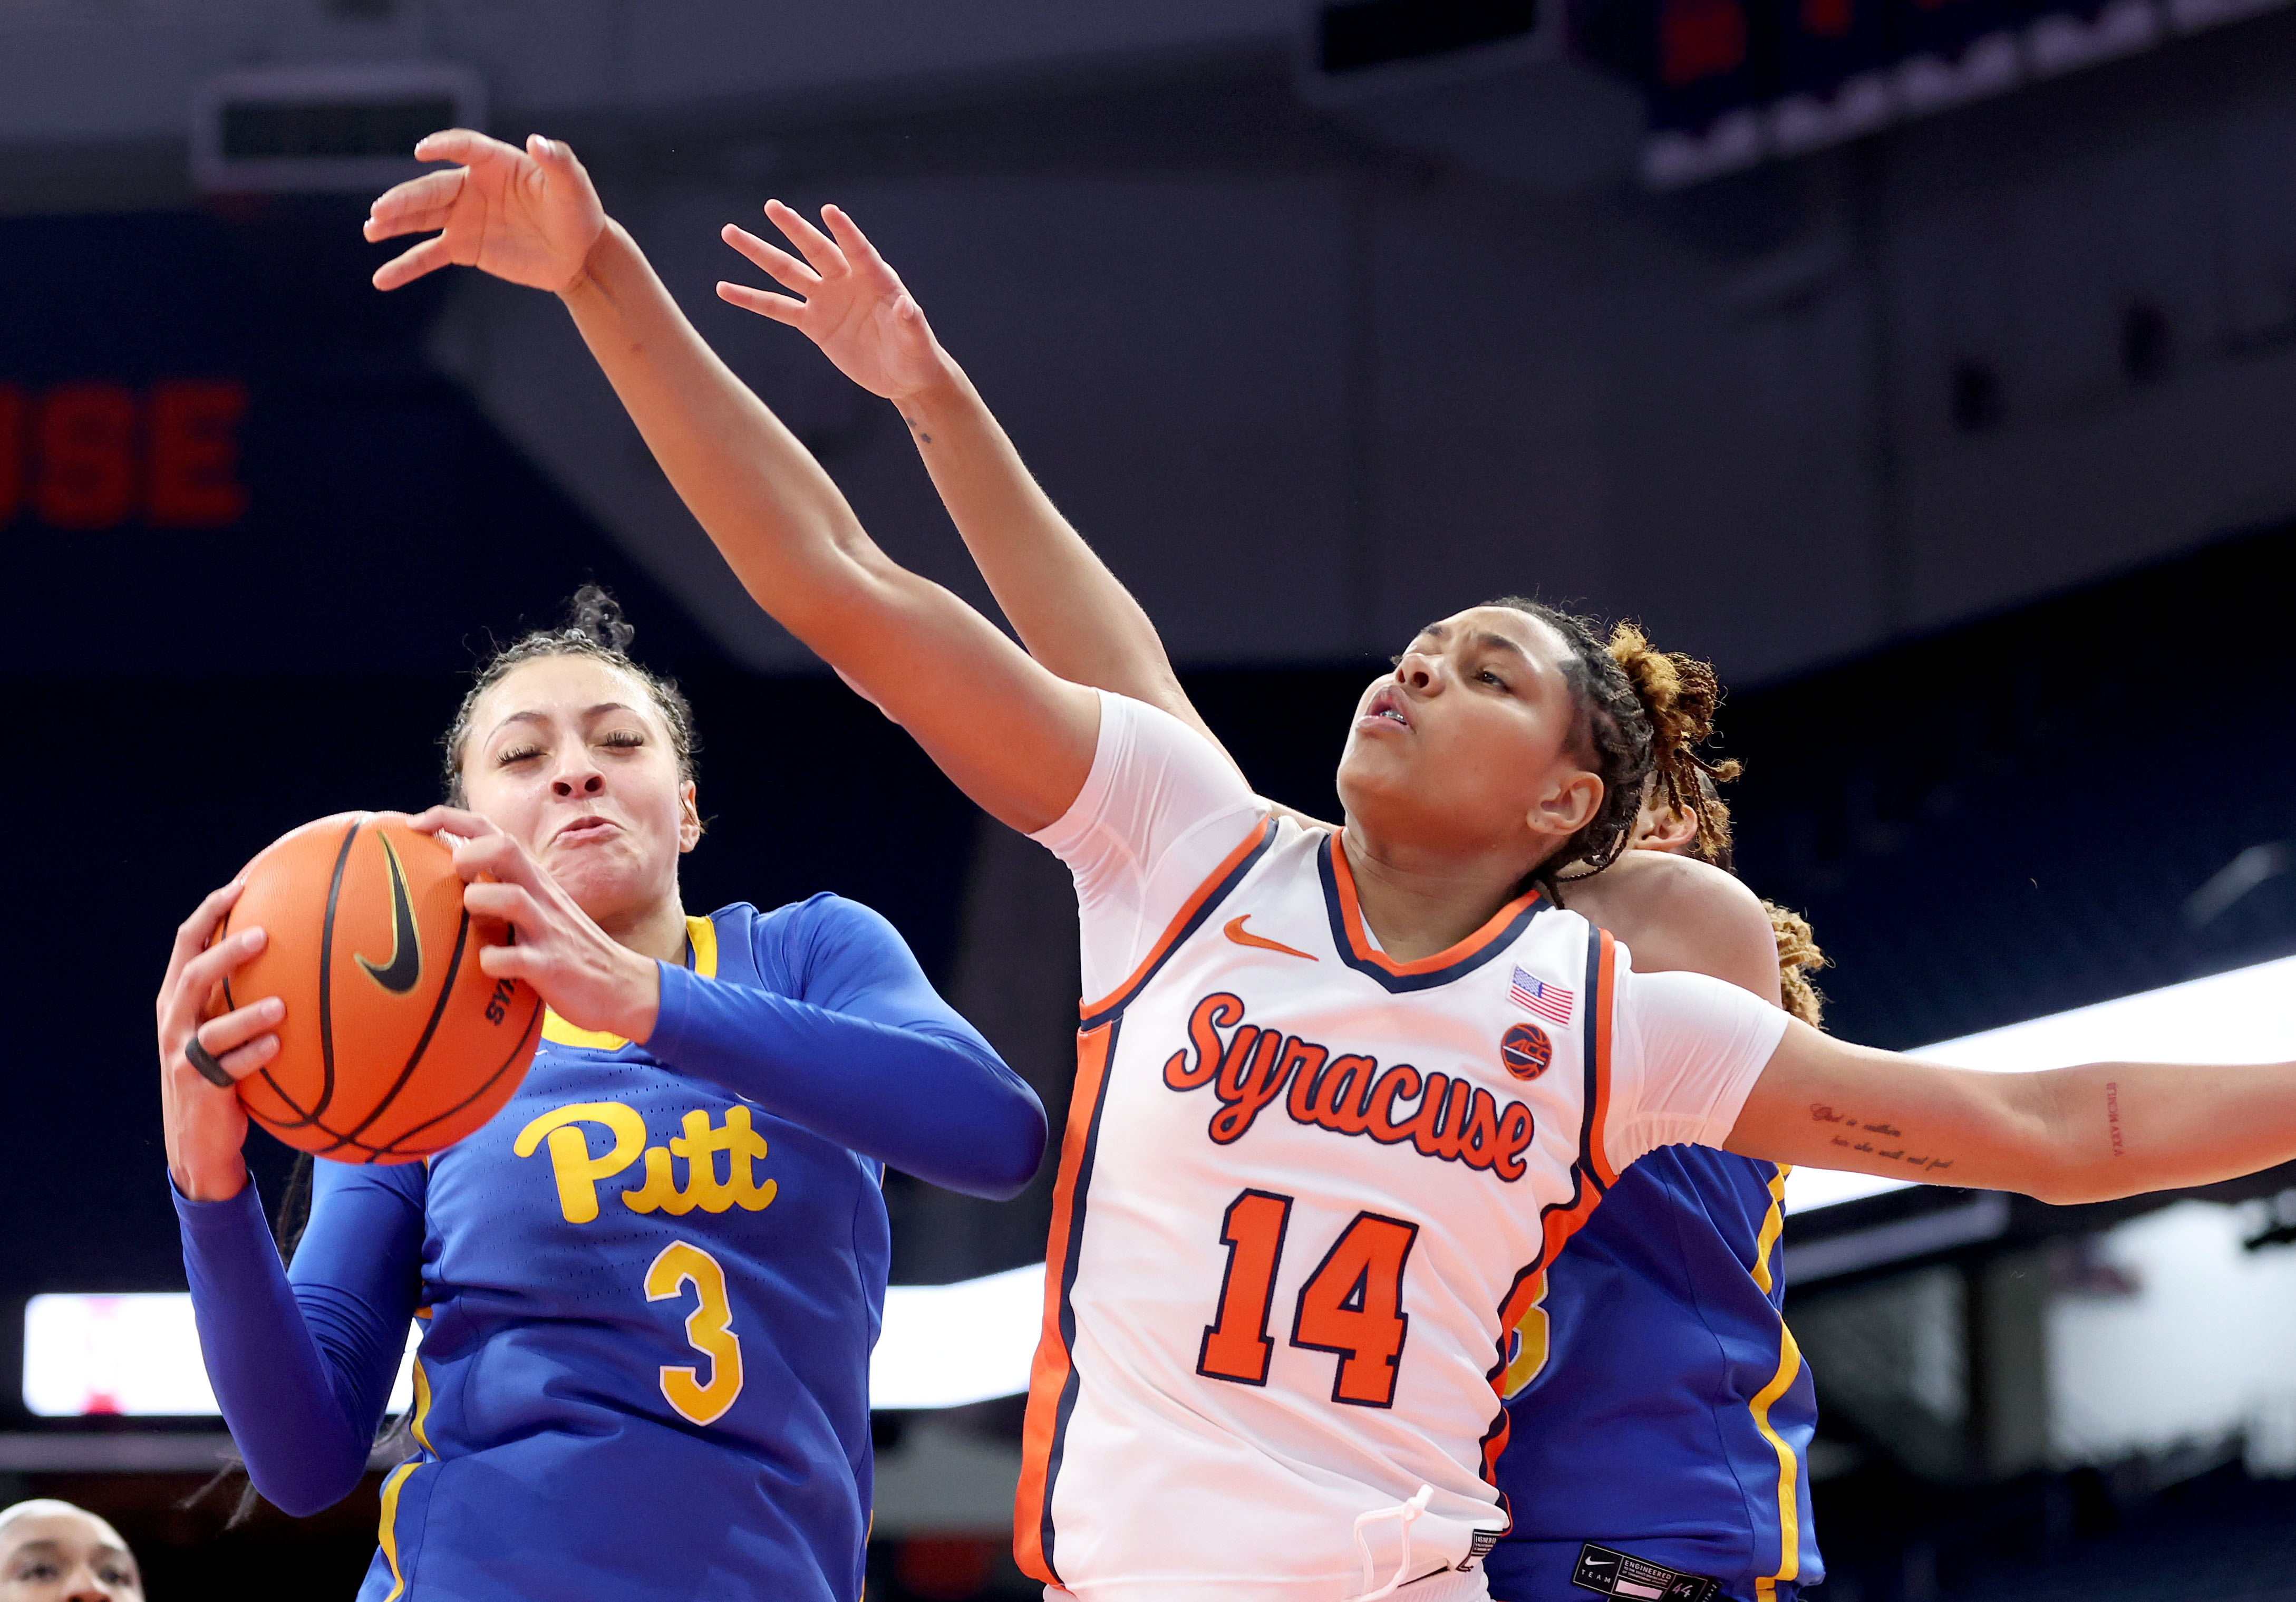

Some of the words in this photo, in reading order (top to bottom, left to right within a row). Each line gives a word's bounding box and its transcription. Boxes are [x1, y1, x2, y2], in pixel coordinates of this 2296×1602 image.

[0, 377, 250, 530] SE
[513, 1101, 778, 1224] Pitt
[1162, 992, 1534, 1182] Syracuse
[643, 1239, 744, 1426] 3
[1196, 1188, 1419, 1408] 14
[1582, 1569, 1611, 1583] TEAM
[1624, 1560, 1671, 1579] ENGINEERED
